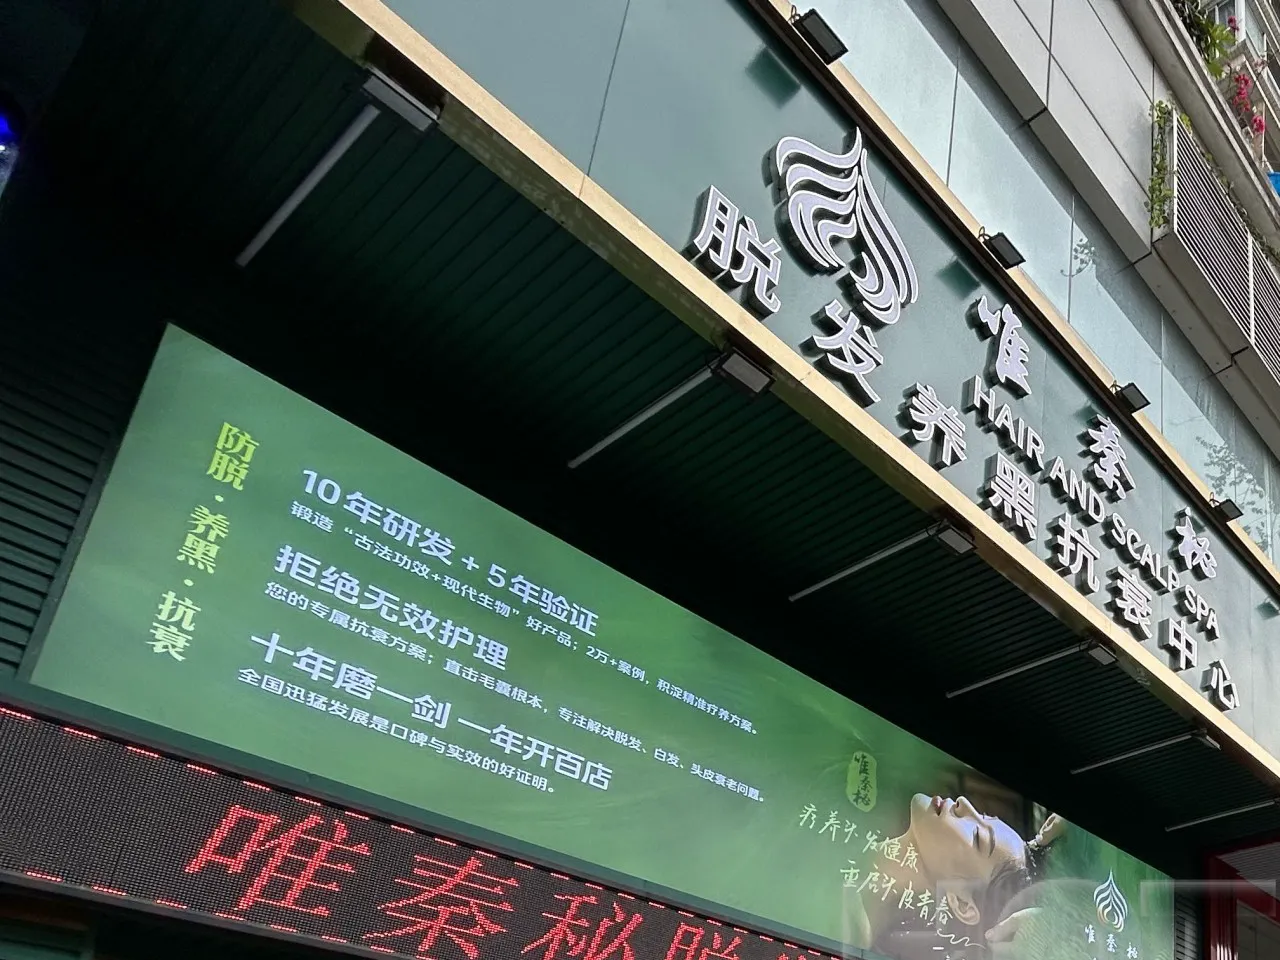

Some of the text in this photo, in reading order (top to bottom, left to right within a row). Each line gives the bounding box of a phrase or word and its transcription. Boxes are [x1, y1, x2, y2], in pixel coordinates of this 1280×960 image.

[693, 184, 1241, 711] 脱发养黑抗衰中心
[969, 374, 1221, 638] HAIR AND SCALP SPA
[250, 632, 614, 791] 十年磨一剑 一年开百店
[274, 544, 511, 670] 拒绝无效护理
